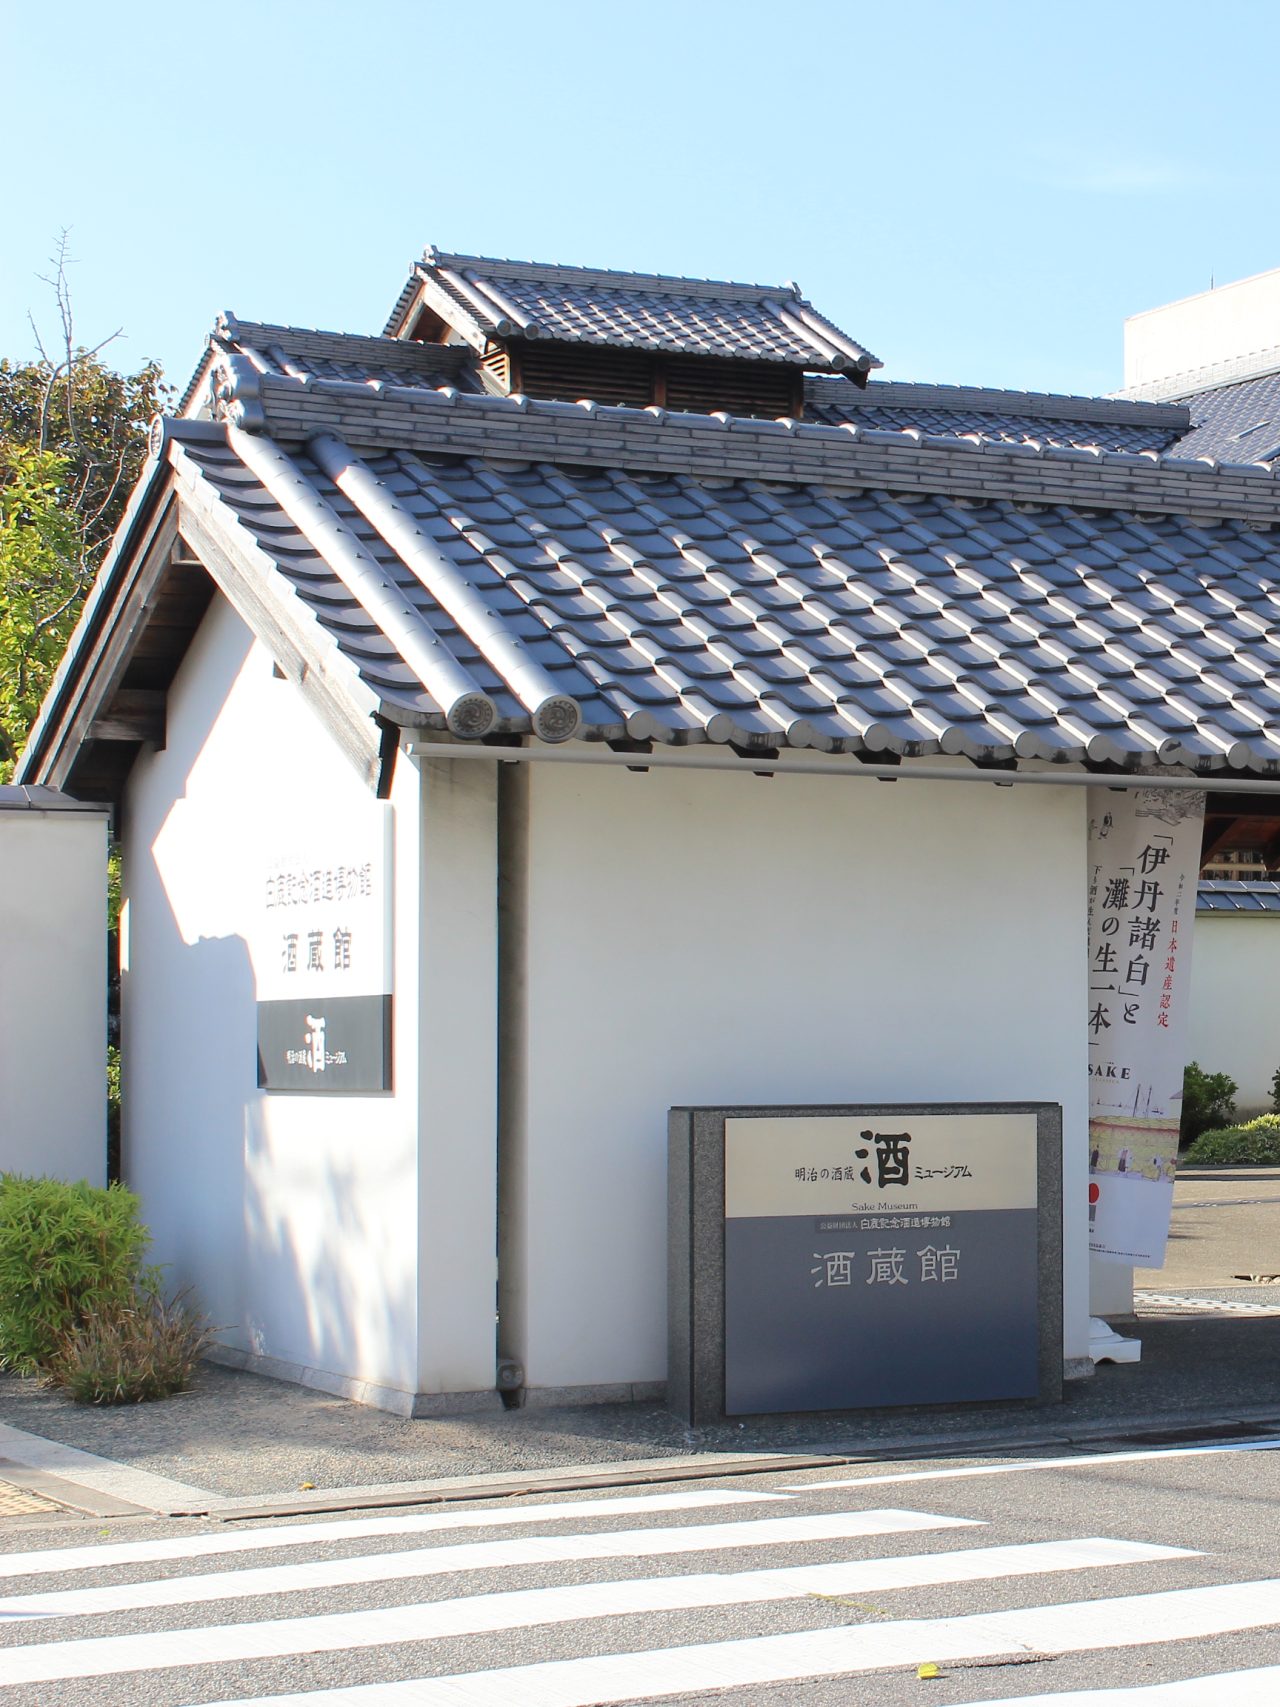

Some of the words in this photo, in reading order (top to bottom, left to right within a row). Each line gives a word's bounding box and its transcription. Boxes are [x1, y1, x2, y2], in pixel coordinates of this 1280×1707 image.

[281, 926, 352, 973] 酒蔵館
[1118, 834, 1173, 1025] 「伊丹諸白」と
[304, 1014, 326, 1073] 酒
[1088, 1063, 1131, 1080] SAKE
[794, 1165, 855, 1182] 明治の酒蔵
[855, 1129, 912, 1188] 酒
[914, 1165, 973, 1180] ミュージアム
[851, 1202, 876, 1212] Sake
[877, 1201, 918, 1212] Museum
[810, 1244, 961, 1288] 酒蔵館
